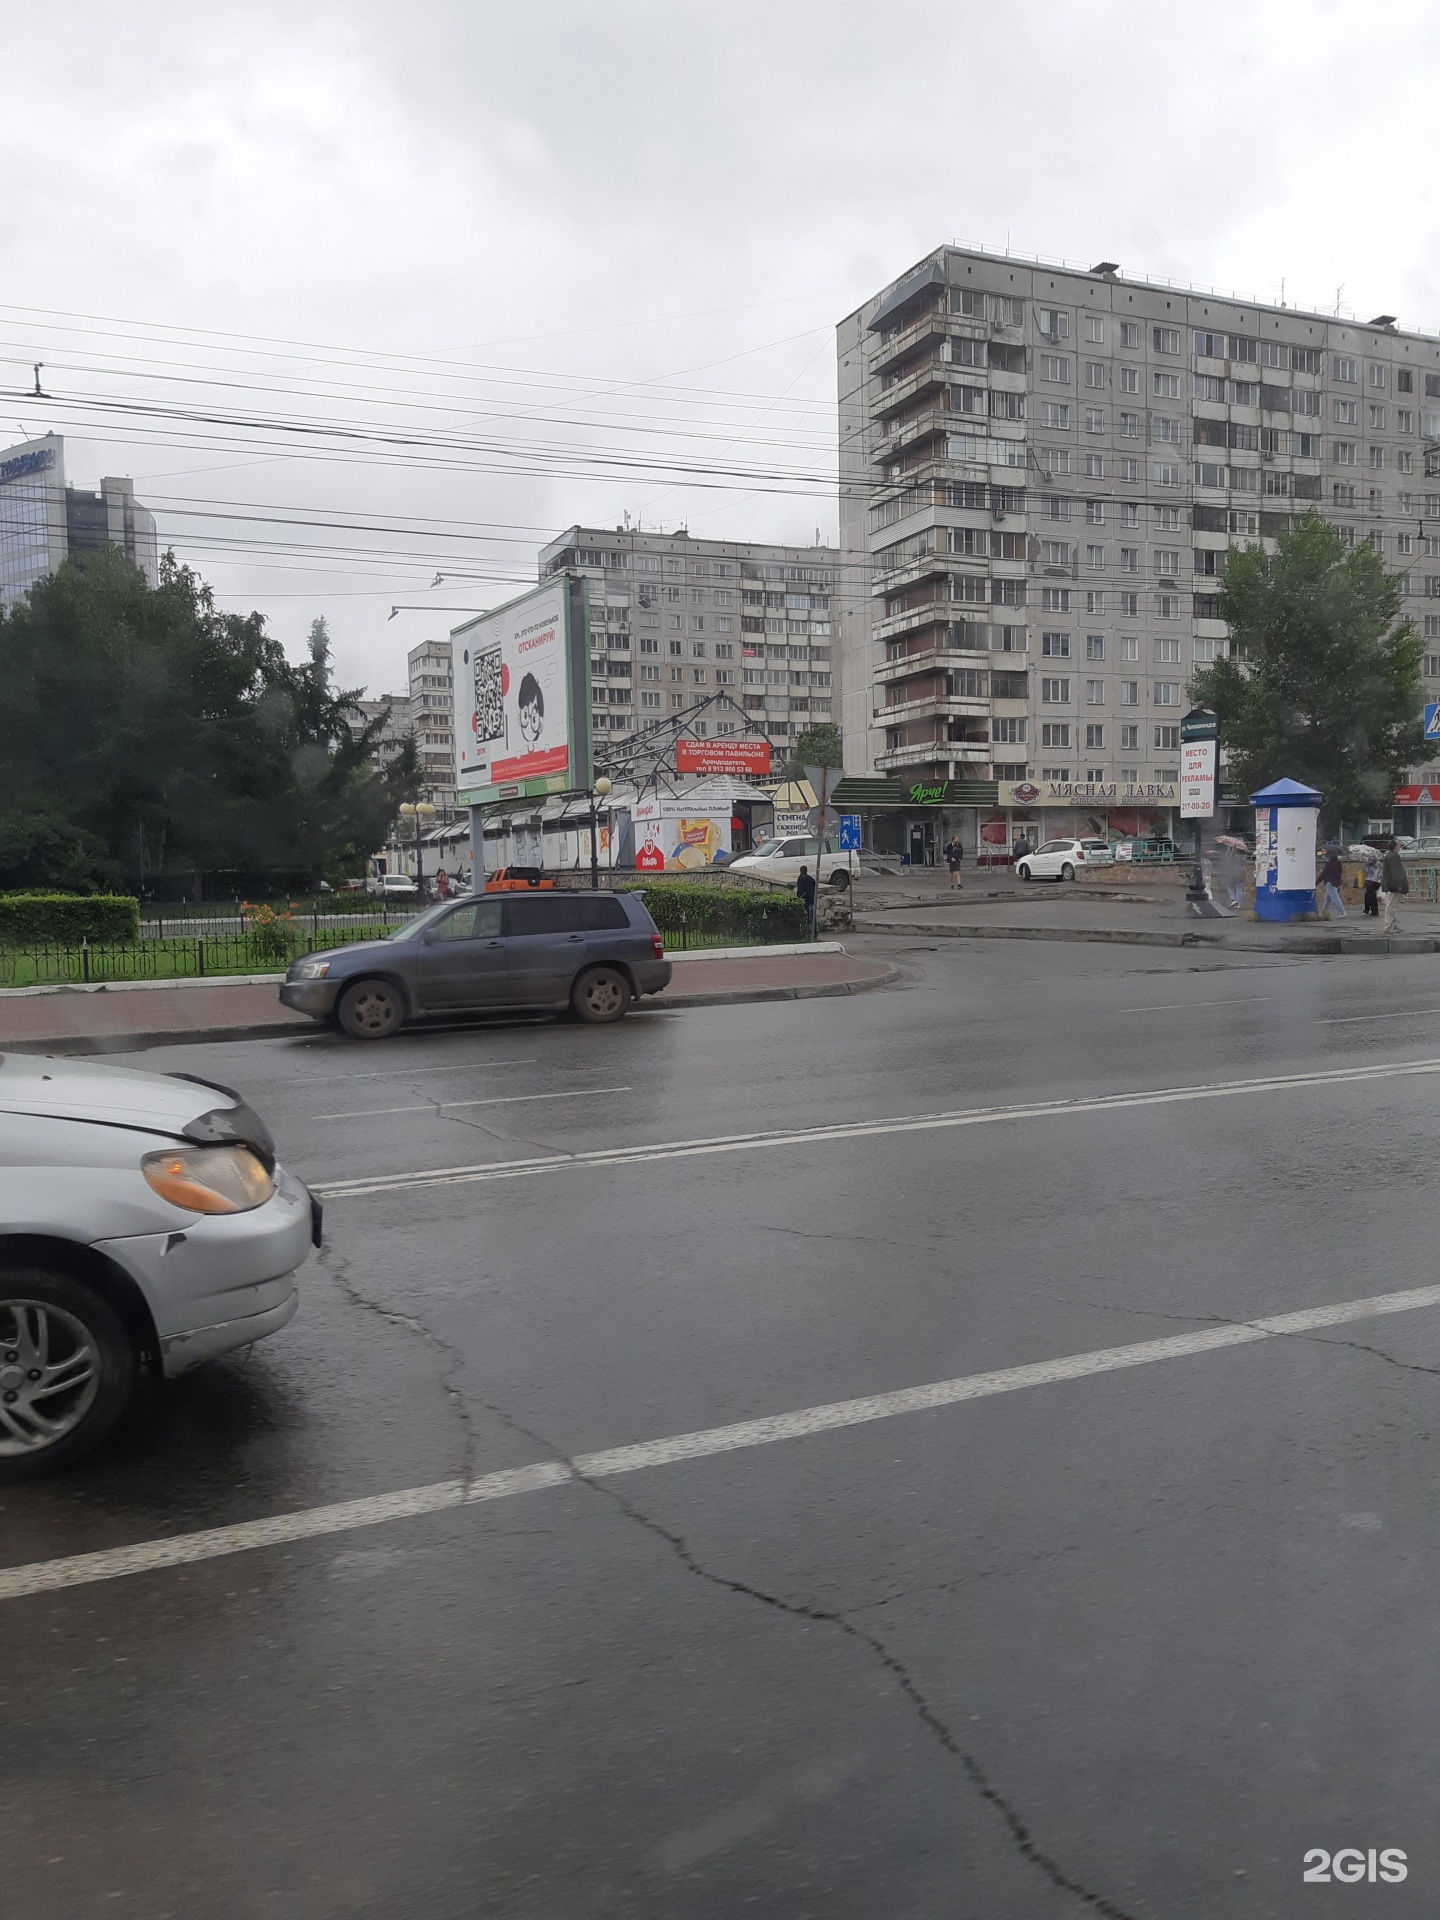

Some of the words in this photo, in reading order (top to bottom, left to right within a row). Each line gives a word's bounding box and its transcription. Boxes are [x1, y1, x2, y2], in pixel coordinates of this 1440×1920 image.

[518, 627, 556, 654] ОТСКАНИРУЙ!
[685, 741, 705, 749] СДАМ
[712, 742, 738, 750] АРЕНДУ
[688, 749, 724, 757] ТОРГОВОМ
[725, 750, 765, 758] ПАВИЛЬОНЕ
[1185, 748, 1208, 758] МЕСТО
[701, 758, 747, 766] Арендодатель
[1188, 761, 1202, 770] ДЛЯ
[1181, 774, 1213, 783] РЕКЛАМЫ
[909, 781, 949, 803] Ярче!
[1047, 783, 1117, 797] МЯСНАЯ
[1123, 783, 1175, 798] ЛАВКА
[1182, 802, 1211, 810] 217-00-20
[777, 814, 807, 822] СЕМЕНА
